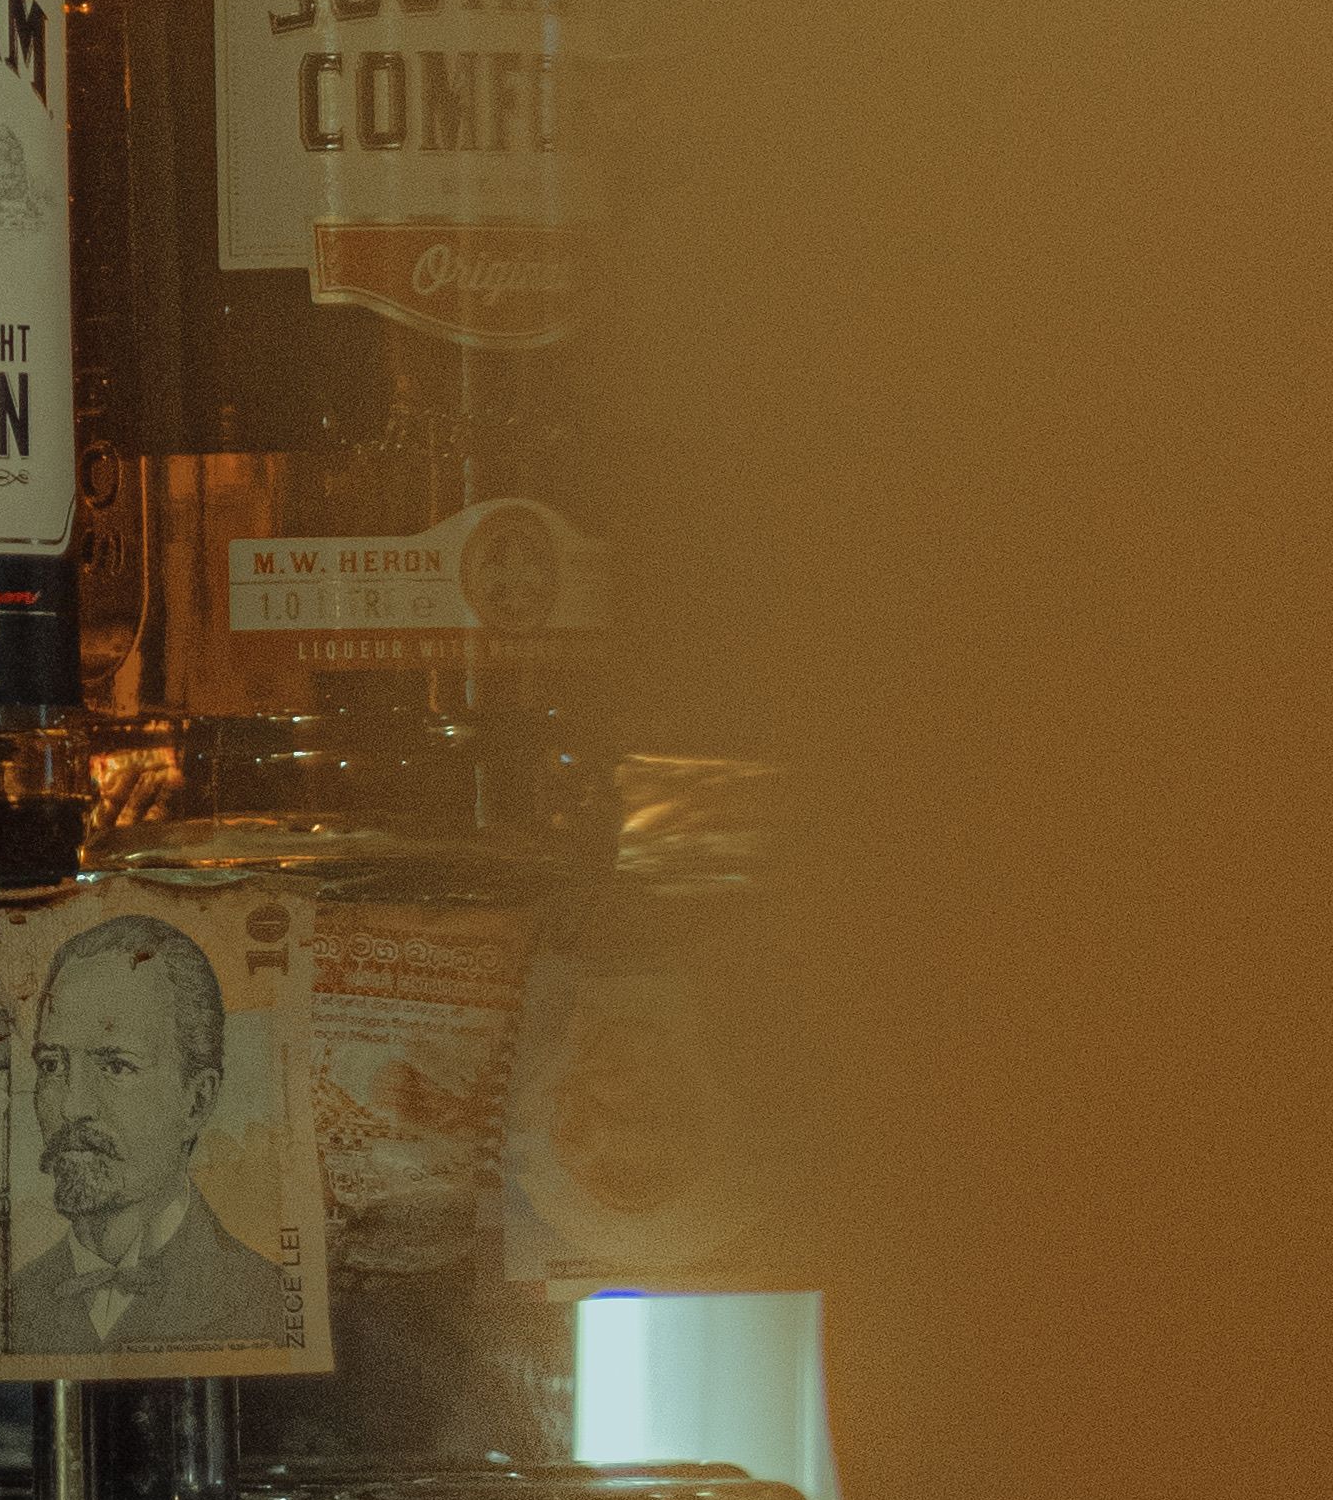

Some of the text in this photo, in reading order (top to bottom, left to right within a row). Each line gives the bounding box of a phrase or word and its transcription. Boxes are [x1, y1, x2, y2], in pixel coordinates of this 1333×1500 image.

[252, 549, 442, 576] M.W. HERON
[297, 640, 403, 661] LIQUEUR
[279, 1224, 308, 1350] ZECE LEI
